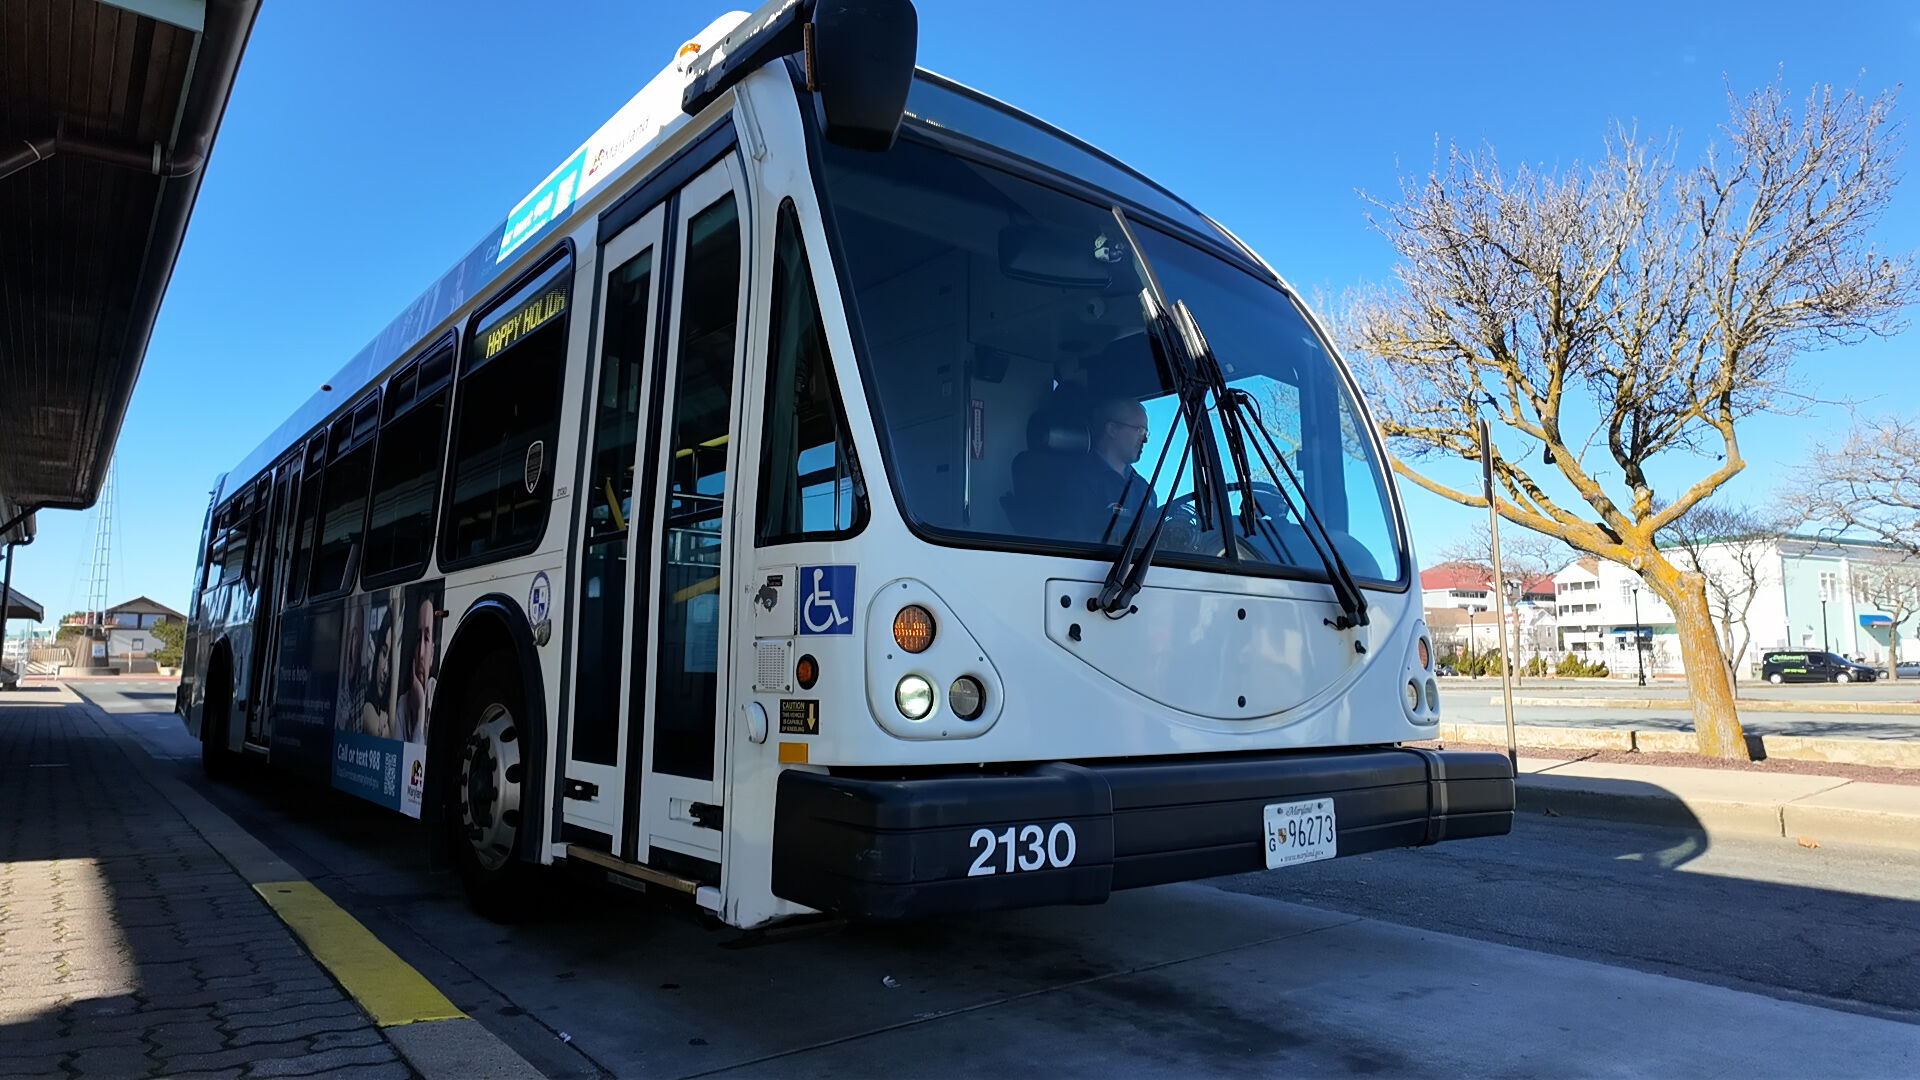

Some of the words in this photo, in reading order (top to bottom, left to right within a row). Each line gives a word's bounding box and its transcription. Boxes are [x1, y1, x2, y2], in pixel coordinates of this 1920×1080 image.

[486, 313, 523, 359] HAPPY
[782, 701, 805, 710] CAUTION
[337, 743, 348, 762] Call
[348, 749, 356, 764] or
[356, 748, 368, 768] text
[368, 749, 380, 771] 988
[1286, 803, 1313, 816] Maryland
[1288, 814, 1333, 848] 96273
[968, 822, 1076, 876] 2130
